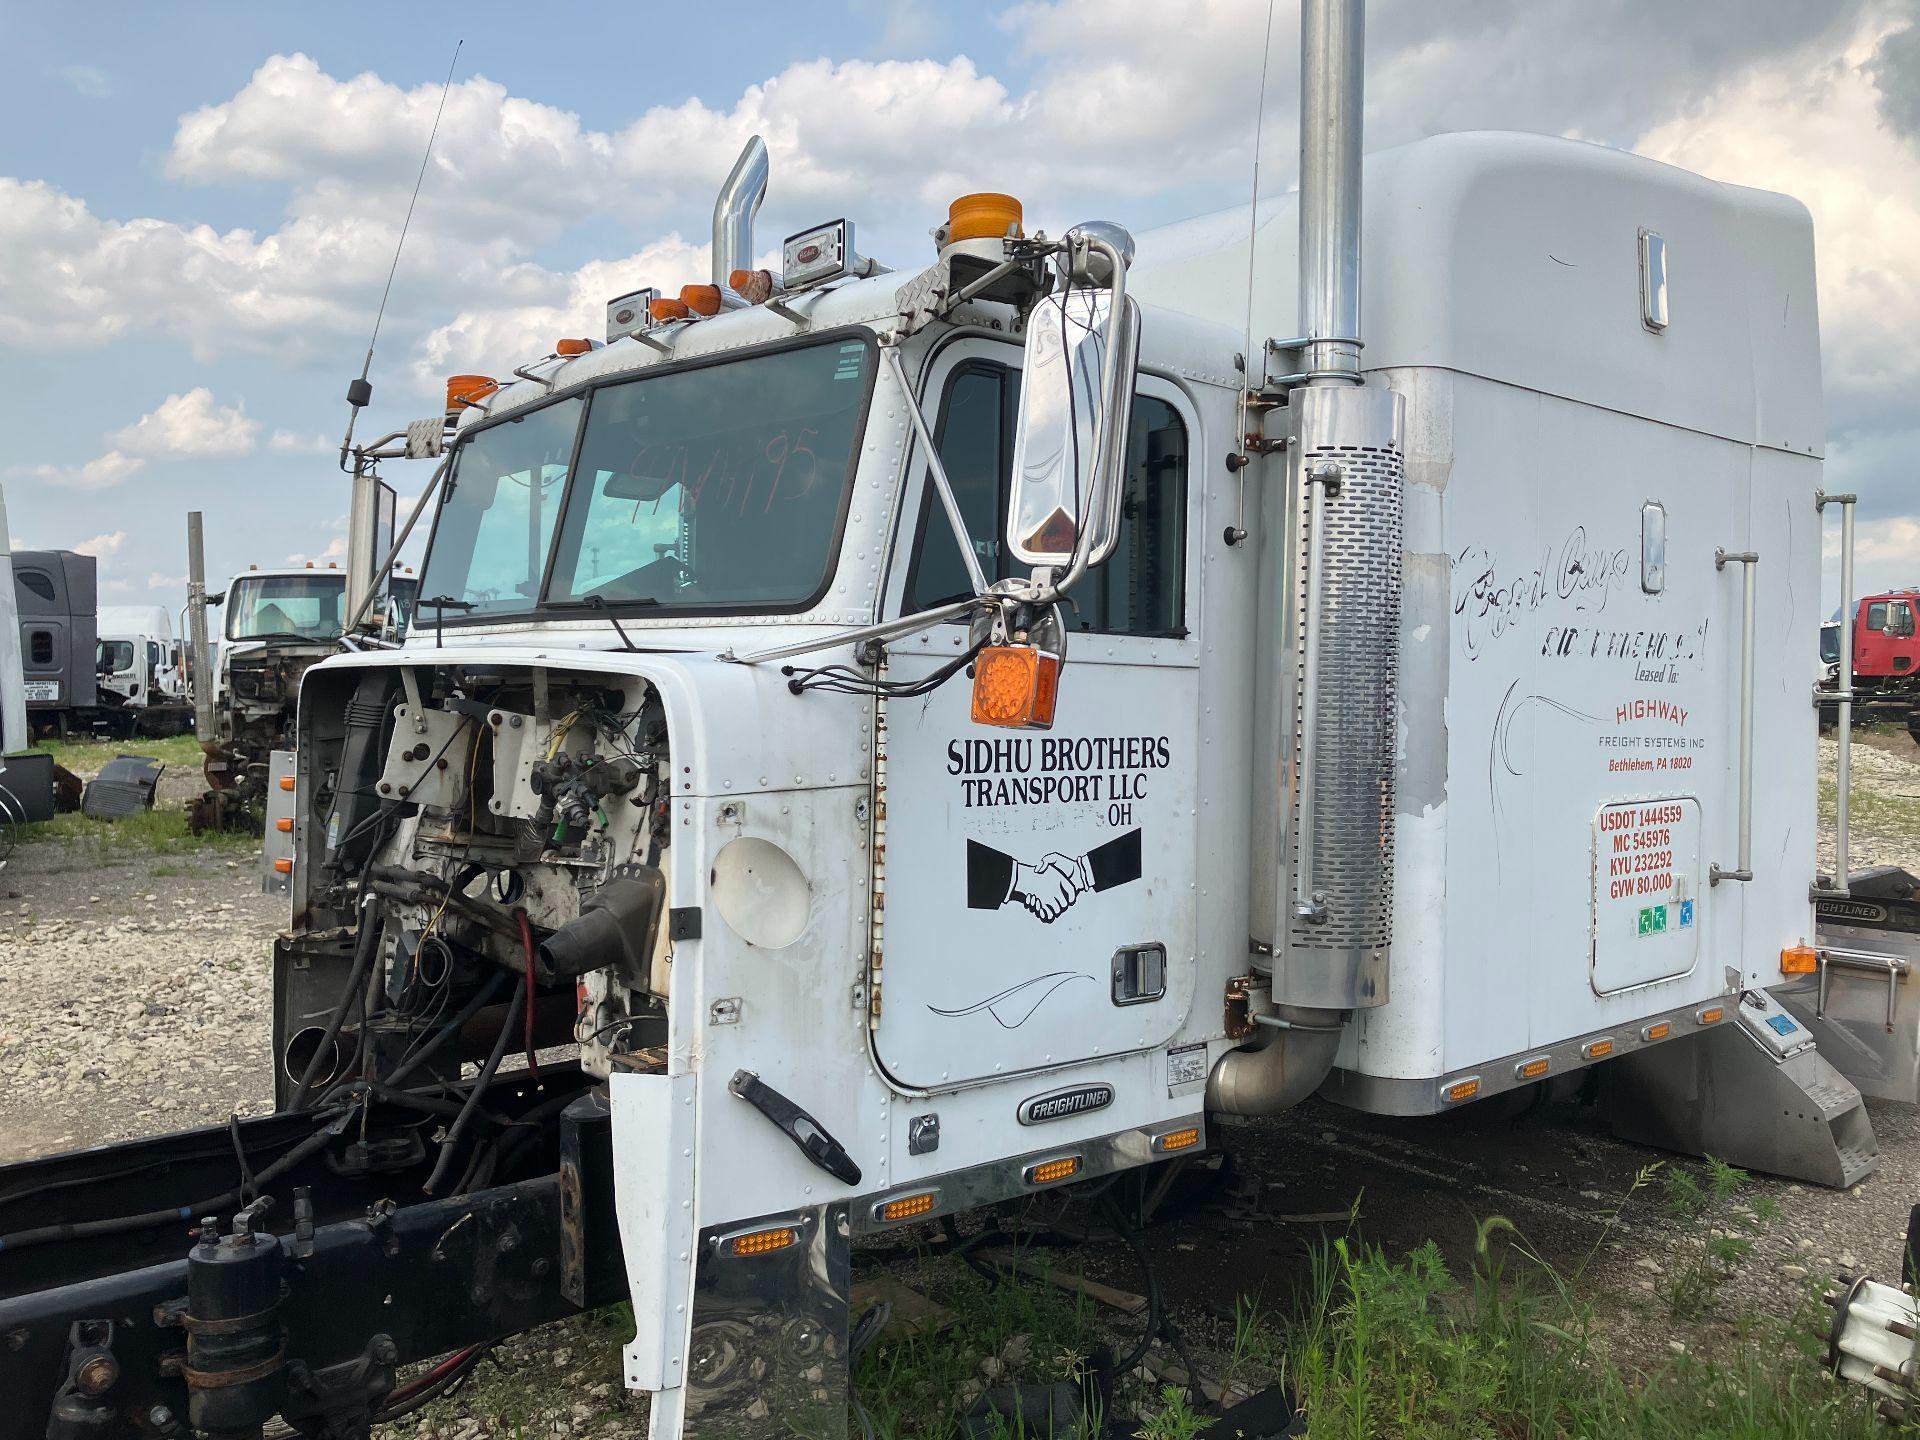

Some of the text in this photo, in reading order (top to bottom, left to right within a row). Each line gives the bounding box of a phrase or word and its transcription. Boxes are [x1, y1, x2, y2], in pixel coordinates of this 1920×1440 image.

[1634, 661, 1680, 683] Leased To:
[1616, 700, 1688, 727] HIGHWAY
[1599, 736, 1705, 749] FREIGHT SYSTEMS INC
[947, 736, 1170, 775] SIDHU BROTHERS
[1608, 756, 1692, 772] Bethlehem, PA 18020
[961, 773, 1148, 807] TRANSPORT LLC
[1108, 803, 1132, 826] OH
[1600, 805, 1682, 832] USDOT 1444559
[1613, 828, 1670, 853] MC 545976
[1610, 850, 1672, 876] KYU 232292
[1610, 878, 1635, 899] GVW
[1816, 902, 1877, 917] IGHTLINER
[1032, 1090, 1109, 1118] FREIGHTLINER
